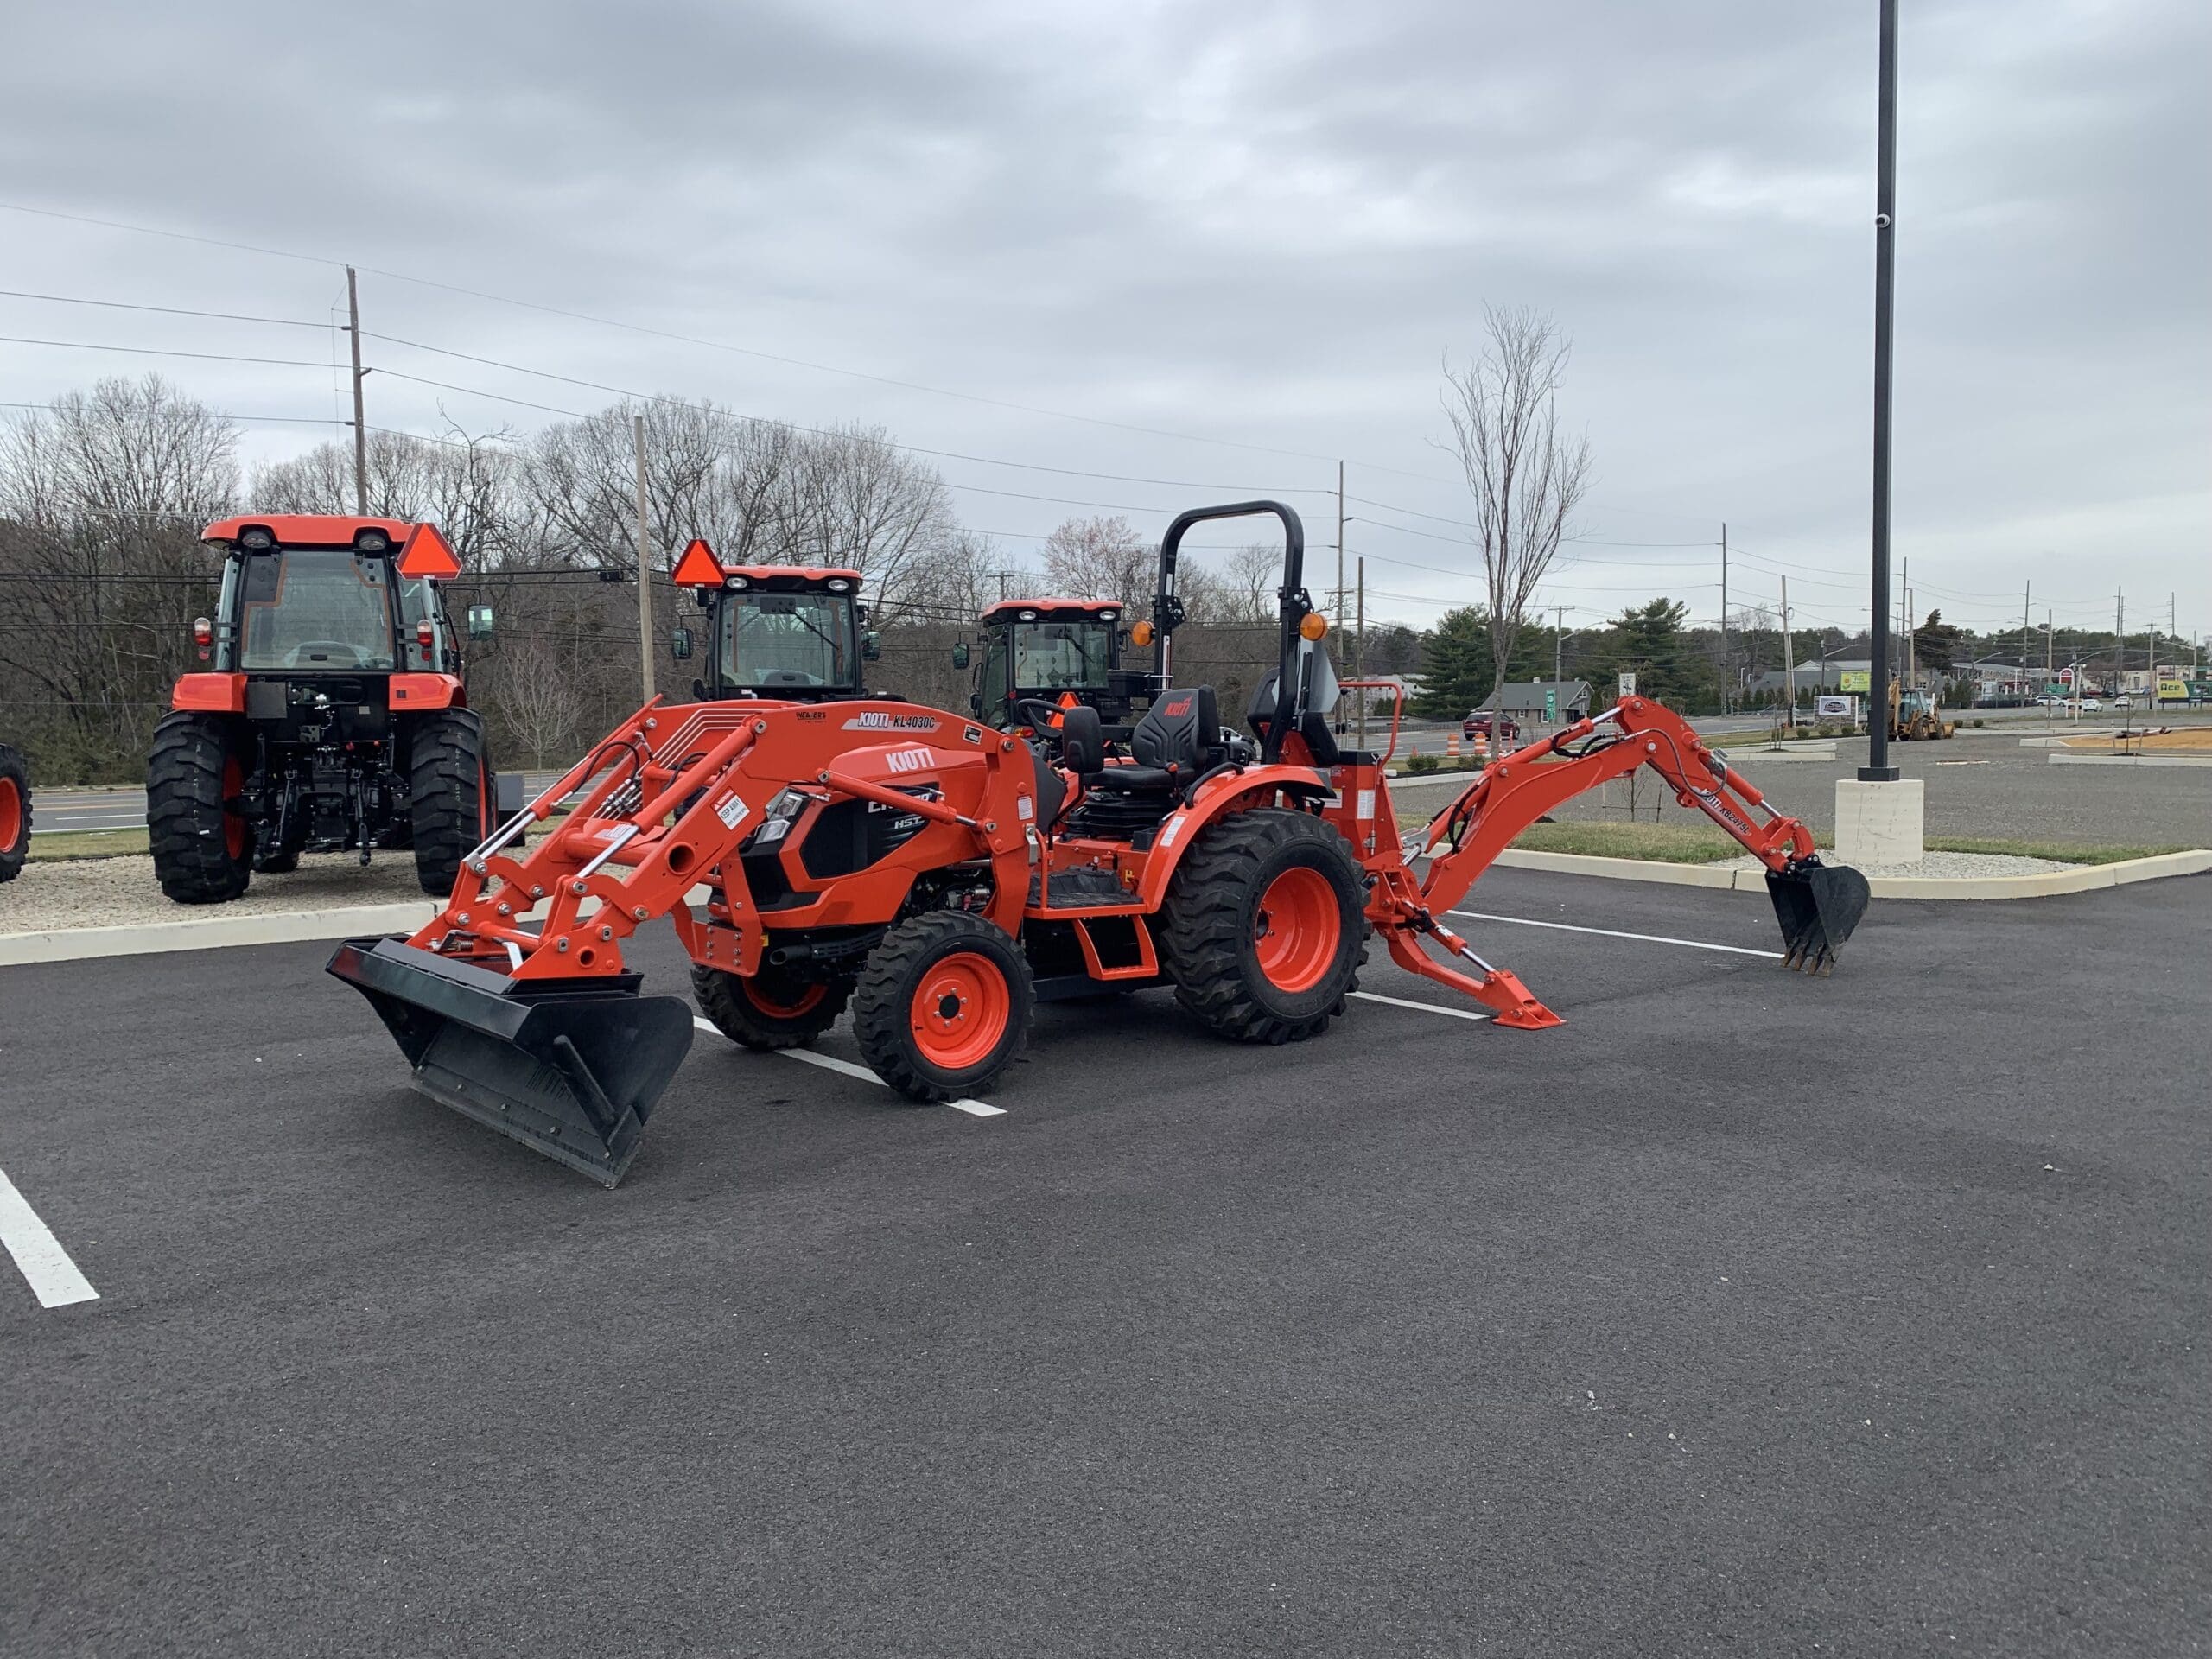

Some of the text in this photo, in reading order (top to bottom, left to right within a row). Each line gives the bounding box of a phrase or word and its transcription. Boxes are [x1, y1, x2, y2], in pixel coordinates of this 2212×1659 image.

[2160, 683, 2180, 691] Ace
[858, 711, 936, 728] KIOTI KL4030C
[885, 747, 935, 773] KIOTI
[1700, 788, 1722, 808] KOTI
